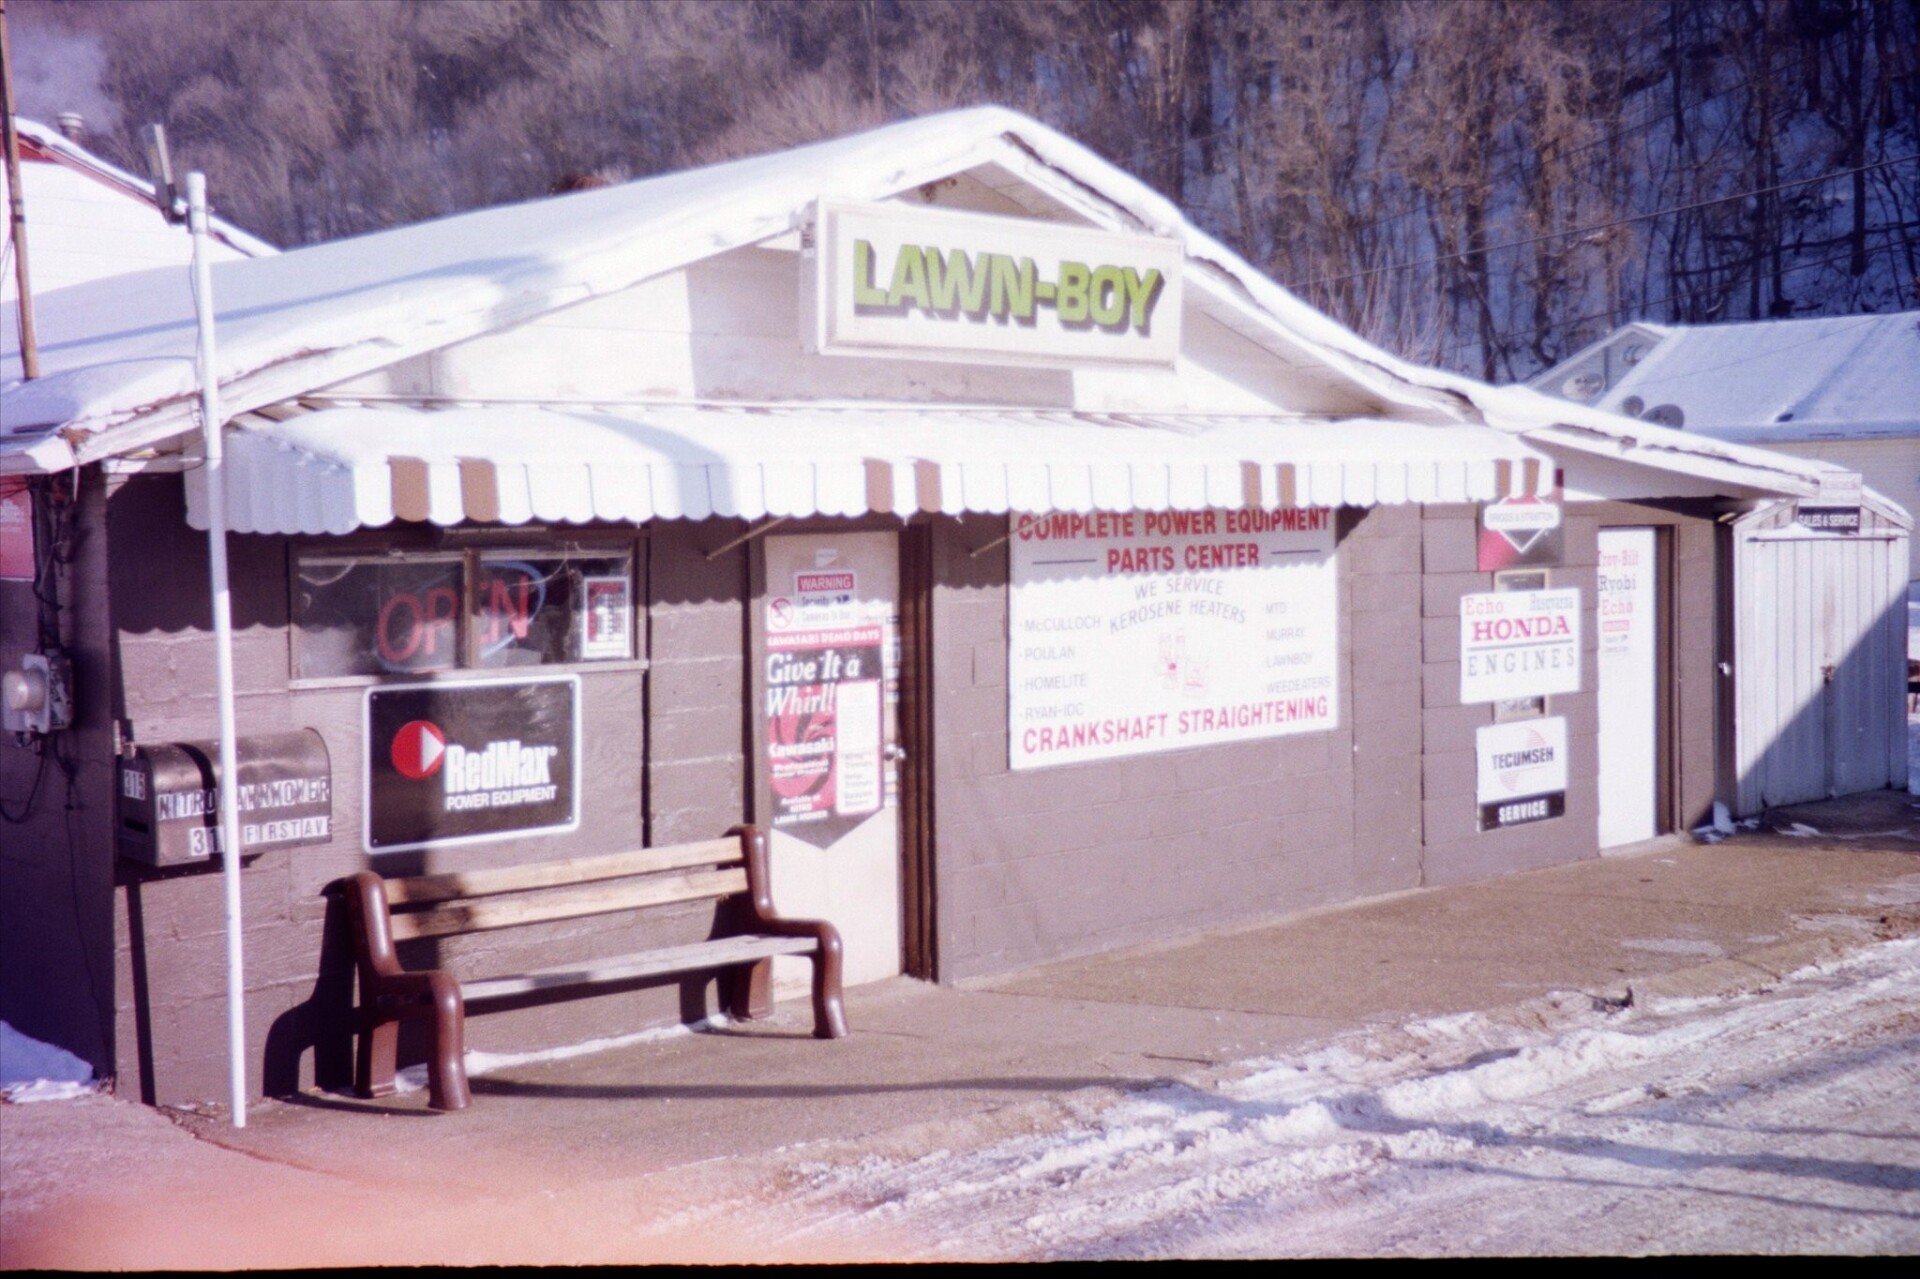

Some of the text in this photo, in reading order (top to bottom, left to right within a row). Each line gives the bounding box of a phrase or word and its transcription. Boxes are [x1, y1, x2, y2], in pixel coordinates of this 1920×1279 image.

[853, 238, 1165, 337] LAWN-BOY
[1018, 507, 1330, 541] COMPLETE POWER EQUIPMENT
[1798, 515, 1821, 527] SALES
[1829, 514, 1859, 526] SERVICE
[1107, 543, 1260, 573] PARTS CENTER
[801, 576, 852, 590] WARNING
[1135, 576, 1224, 600] WE SERVICE
[1598, 574, 1637, 595] Ryobi
[377, 574, 529, 662] OPN
[1109, 600, 1246, 635] KEROSENE HEATERS
[1465, 597, 1504, 616] Echo
[1024, 615, 1101, 632] McCULLOCH
[1472, 614, 1571, 642] HONDA
[767, 650, 861, 684] Give It a
[1024, 646, 1075, 661] POULAN
[1467, 646, 1575, 677] ENGINES
[1024, 673, 1087, 691] HOMELITE
[1022, 695, 1328, 755] CRANKSHAFT STRAIGHTENING
[446, 740, 551, 793] RedMax
[1492, 746, 1554, 769] TECUMSEH
[158, 788, 217, 819] NITRO
[447, 785, 557, 811] POWER EQUIPMENT
[1498, 799, 1547, 823] SERVICE
